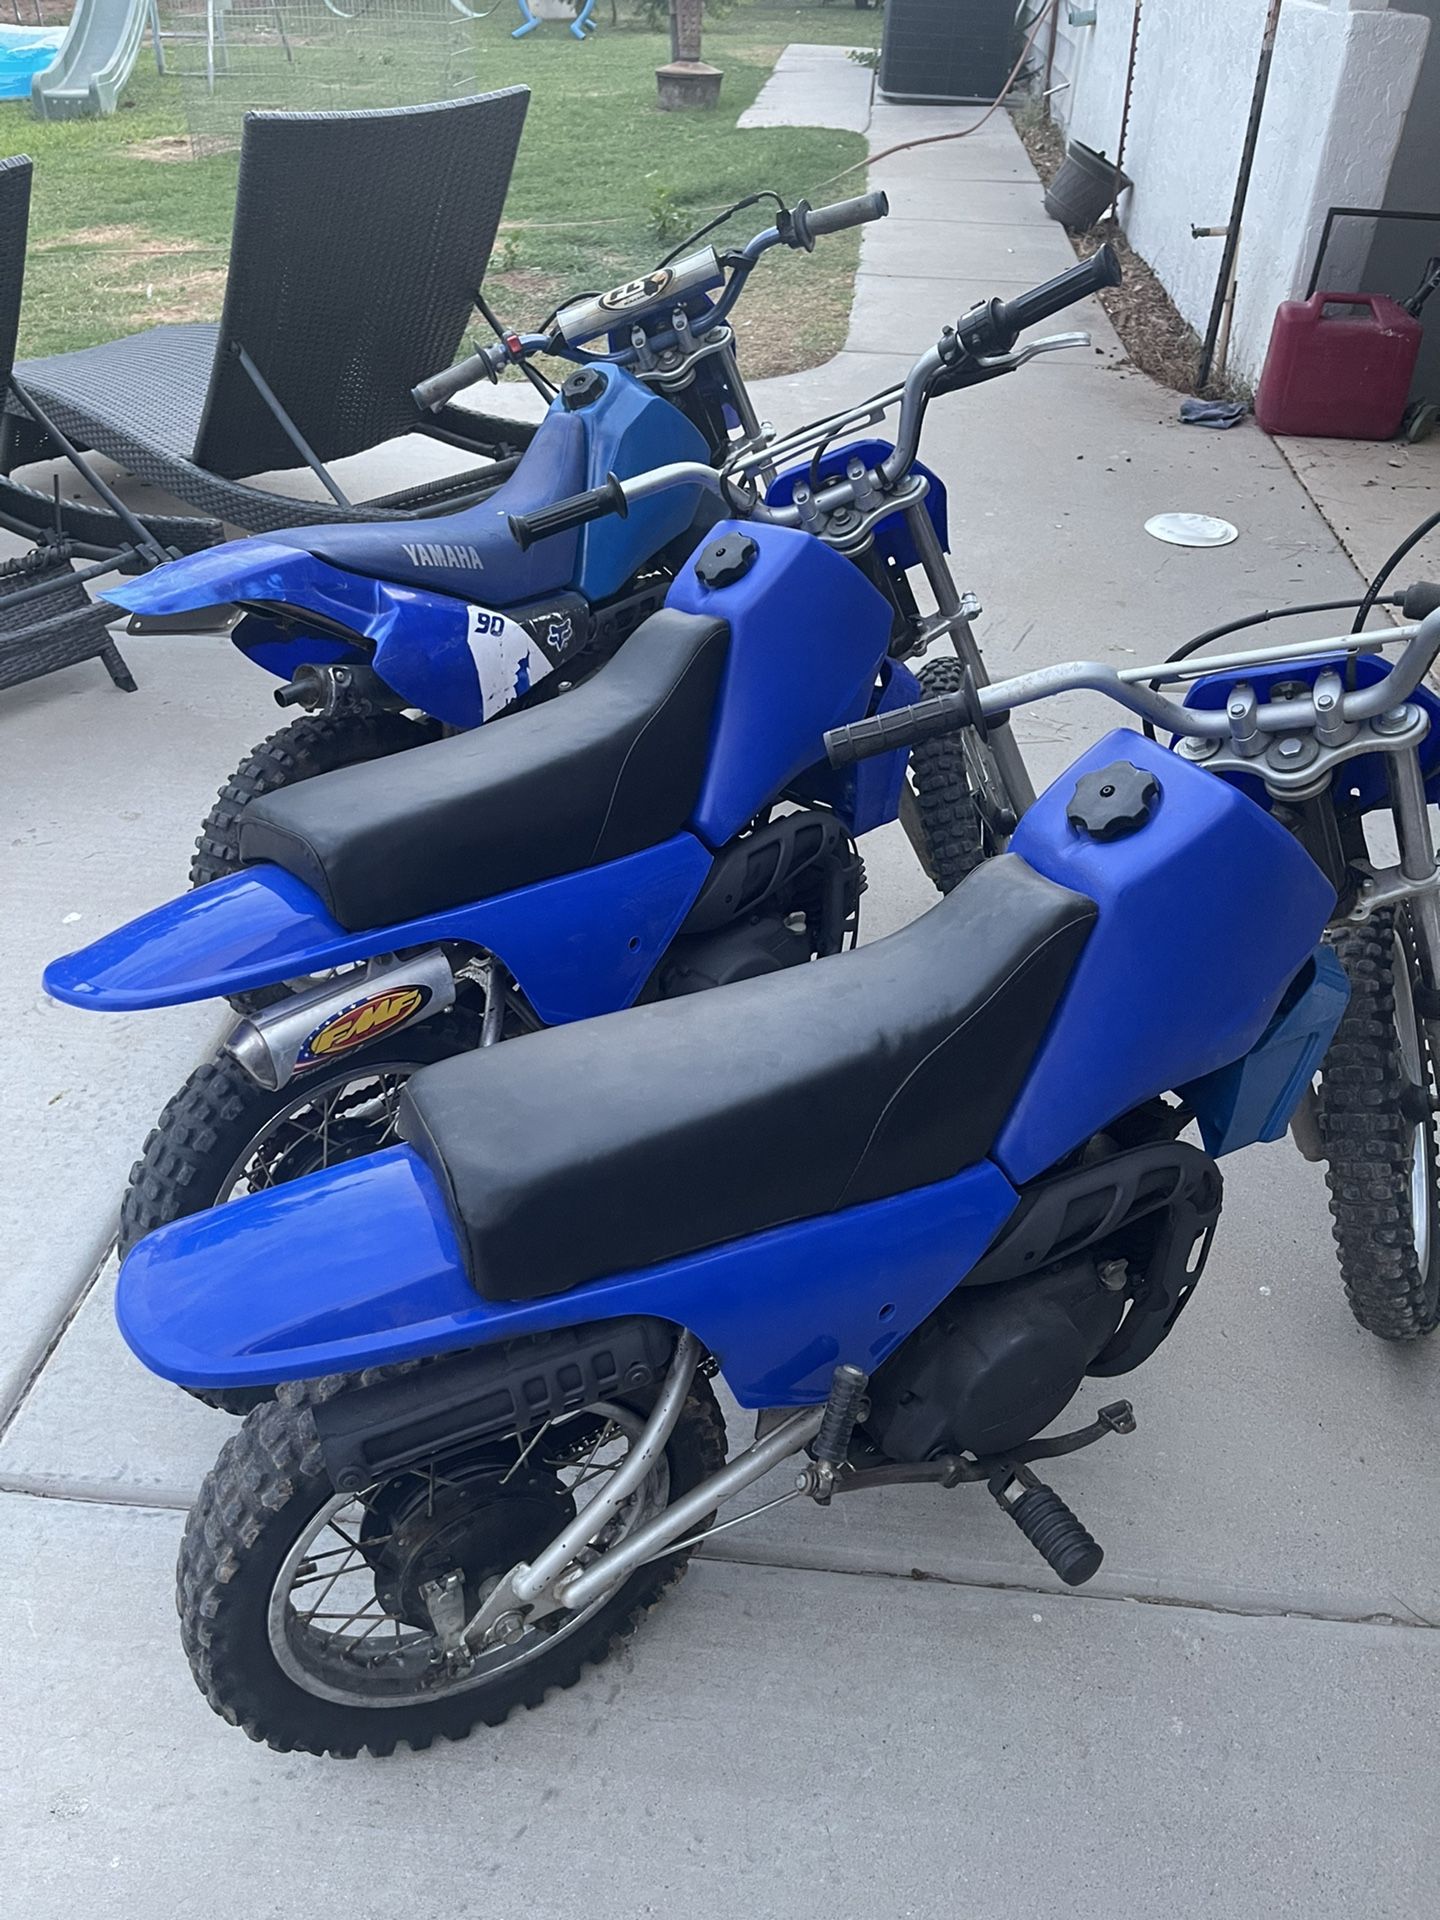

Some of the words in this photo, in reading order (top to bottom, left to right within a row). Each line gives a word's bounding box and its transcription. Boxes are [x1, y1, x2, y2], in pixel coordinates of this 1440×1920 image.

[402, 544, 484, 570] YAMAHA
[474, 612, 504, 637] 90
[312, 989, 420, 1055] FMF
